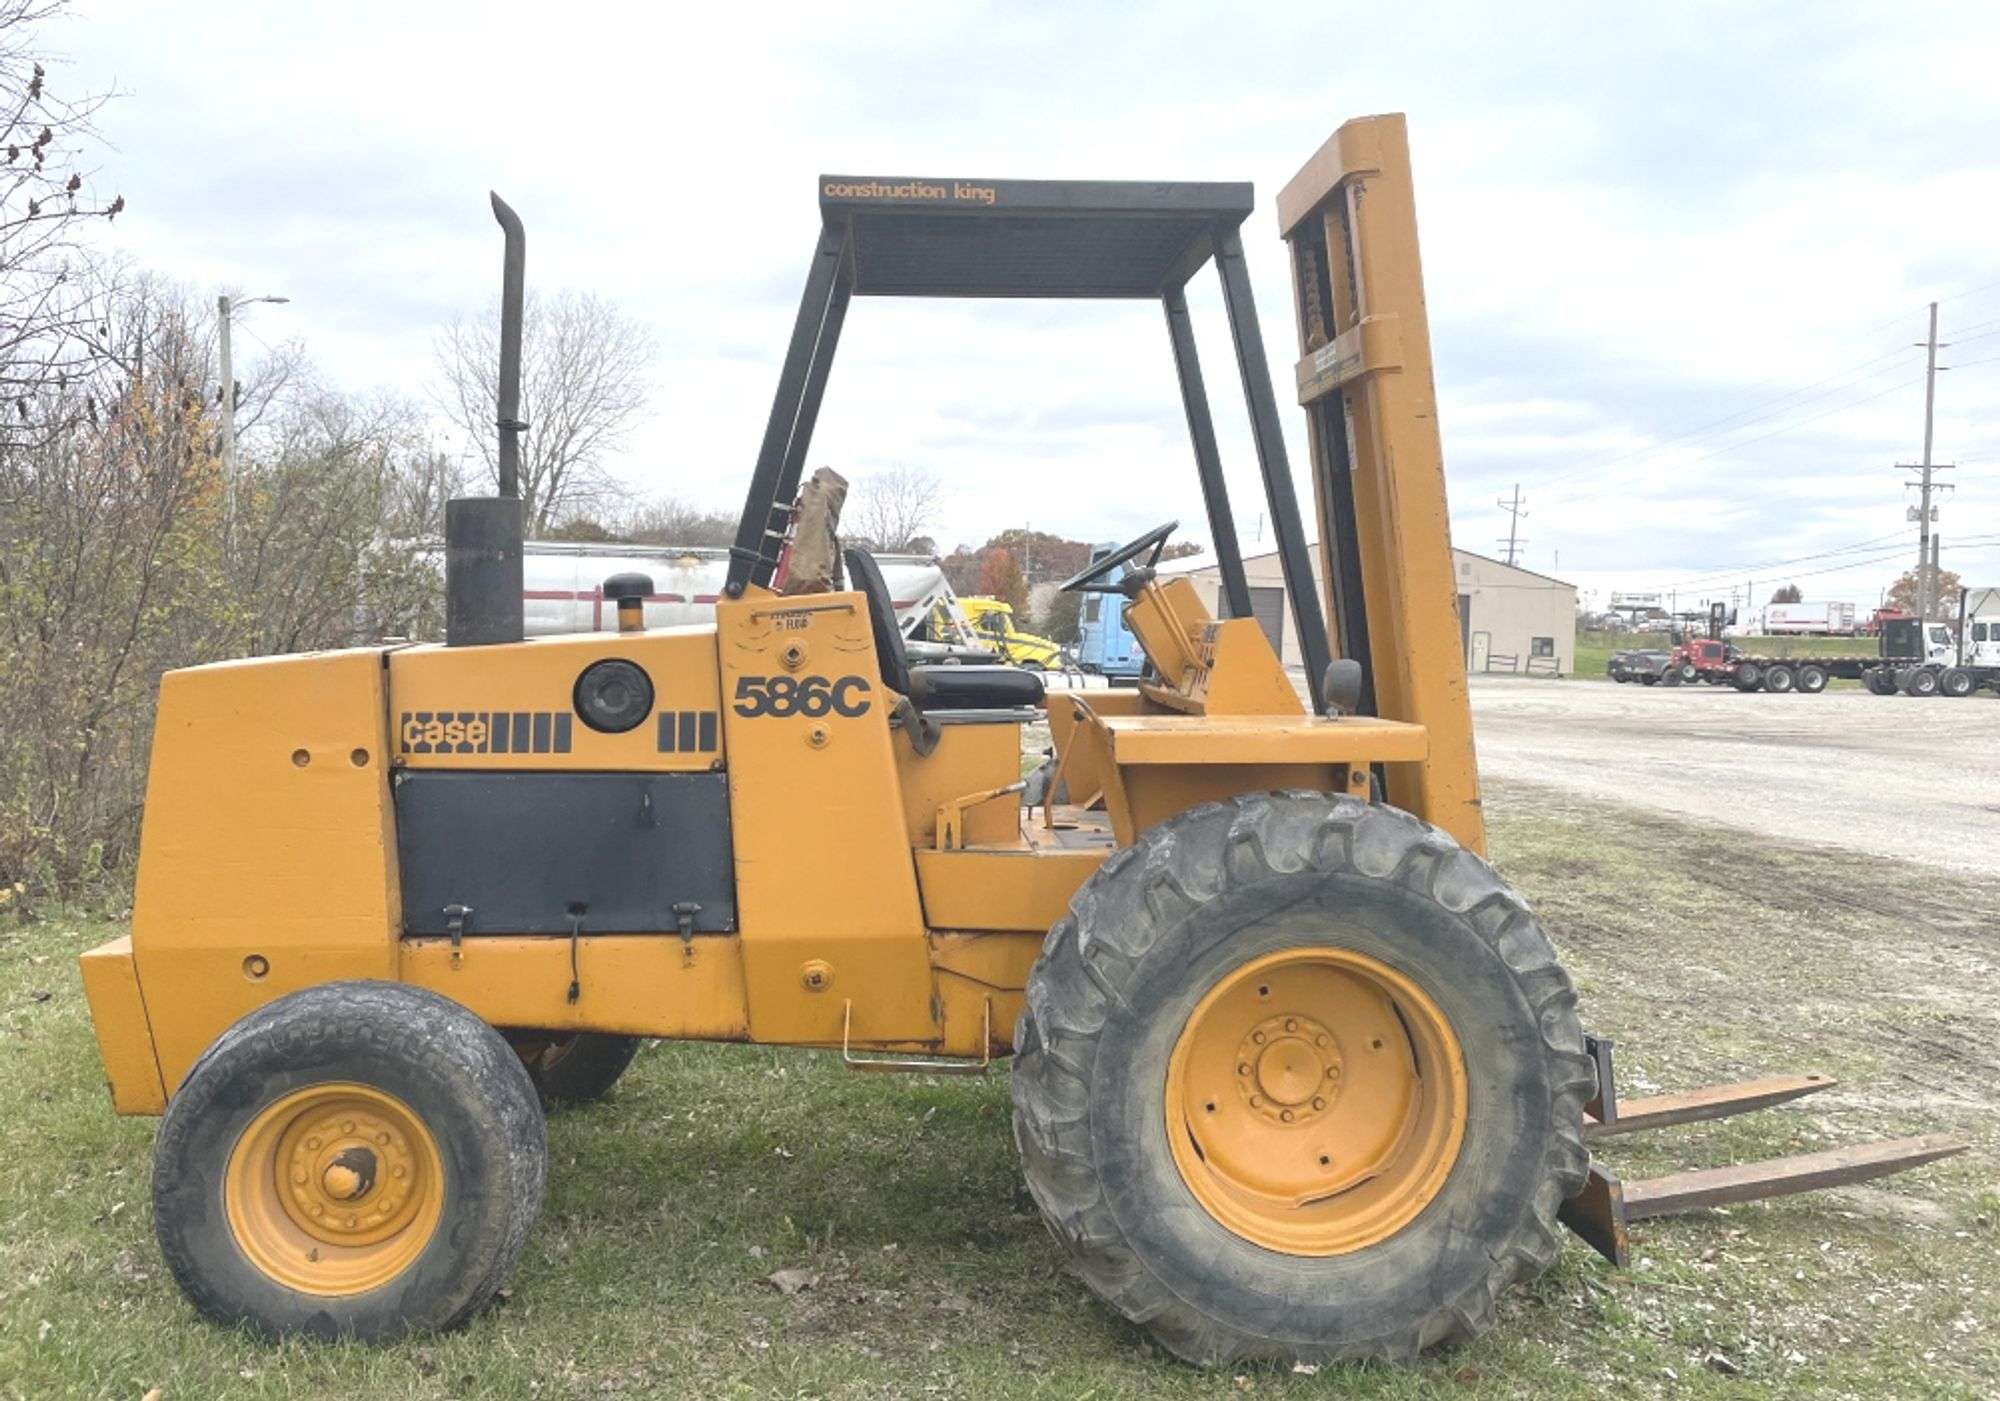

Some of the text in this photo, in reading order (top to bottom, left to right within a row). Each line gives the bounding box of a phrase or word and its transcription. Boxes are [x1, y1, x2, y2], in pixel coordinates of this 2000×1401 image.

[824, 182, 996, 204] construction king
[733, 676, 872, 718] 586C
[402, 718, 487, 745] case
